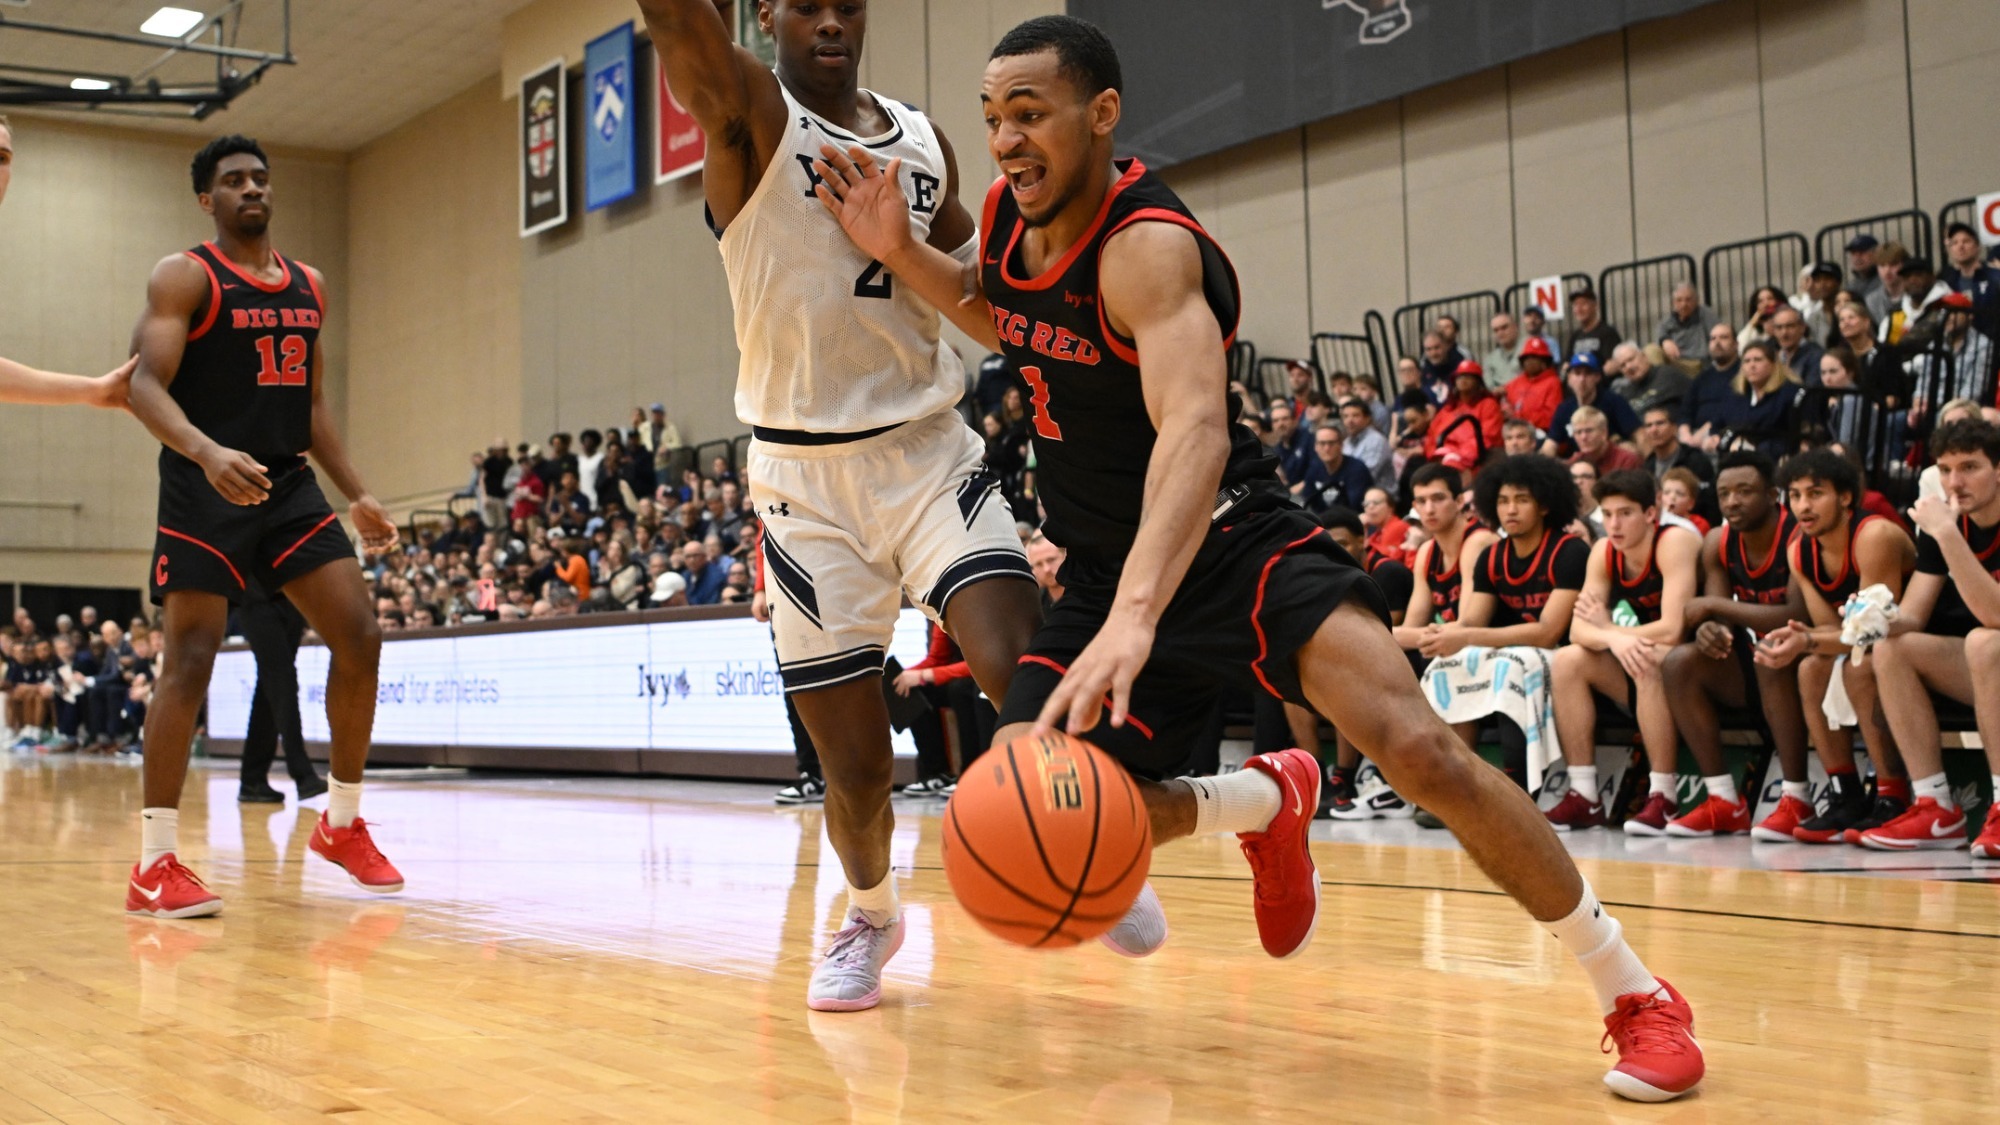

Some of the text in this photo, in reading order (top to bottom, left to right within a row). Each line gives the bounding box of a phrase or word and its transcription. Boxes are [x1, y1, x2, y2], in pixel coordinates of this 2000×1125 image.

[1536, 284, 1557, 313] N
[231, 308, 320, 329] BIG RED
[255, 335, 307, 386] 12
[1031, 320, 1101, 366] RED
[1020, 366, 1064, 441] 1
[156, 554, 168, 587] C
[434, 674, 500, 703] athletes
[638, 665, 671, 707] Ivy
